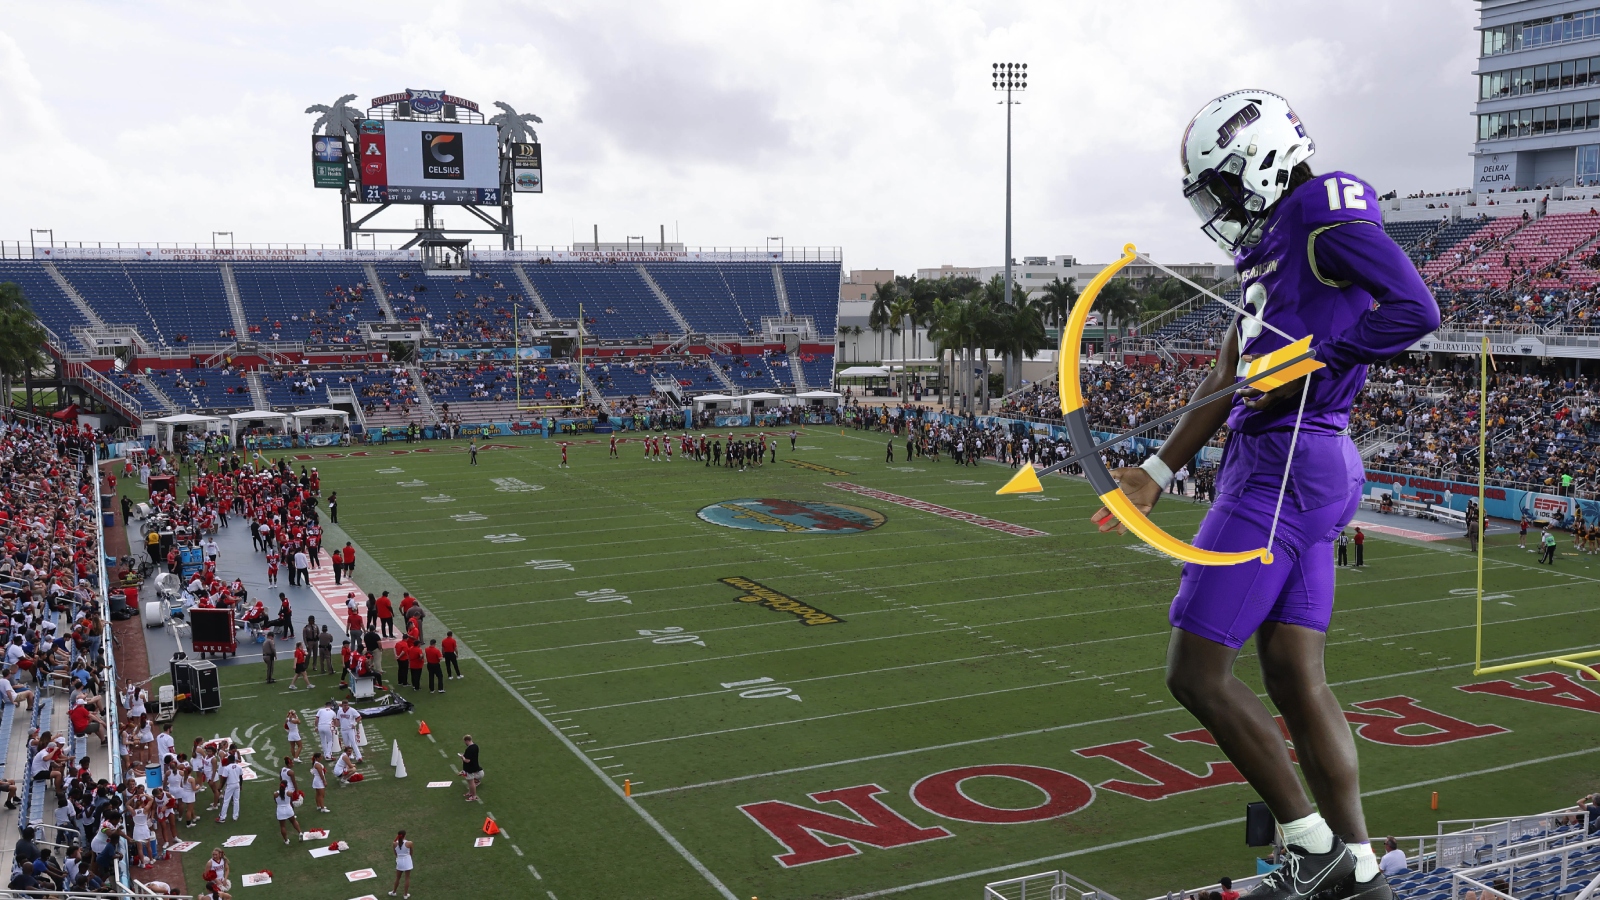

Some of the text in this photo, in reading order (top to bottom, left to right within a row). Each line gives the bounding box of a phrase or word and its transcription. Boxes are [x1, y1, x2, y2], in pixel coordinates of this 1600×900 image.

[373, 92, 408, 106] SCHMIDT
[410, 90, 444, 100] FAU
[448, 95, 479, 111] FAMILY
[1216, 102, 1262, 149] JMU
[365, 143, 381, 155] A
[428, 165, 460, 174] CELSIUS
[1483, 164, 1509, 173] DELRAY
[1479, 174, 1511, 183] ACURA
[367, 190, 380, 198] 21
[419, 191, 446, 201] 4:54
[484, 193, 497, 201] 24
[1324, 177, 1368, 211] 12
[1433, 343, 1461, 351] DELRAY
[1496, 345, 1517, 353] DECK
[681, 396, 693, 406] 25
[462, 424, 501, 435] Roofaim
[1408, 477, 1507, 501] SCHNELLENBEGER
[1533, 497, 1569, 513] ESPN
[524, 558, 572, 572] 40
[574, 587, 629, 603] 30
[636, 625, 700, 645] 20
[720, 676, 793, 700] 10
